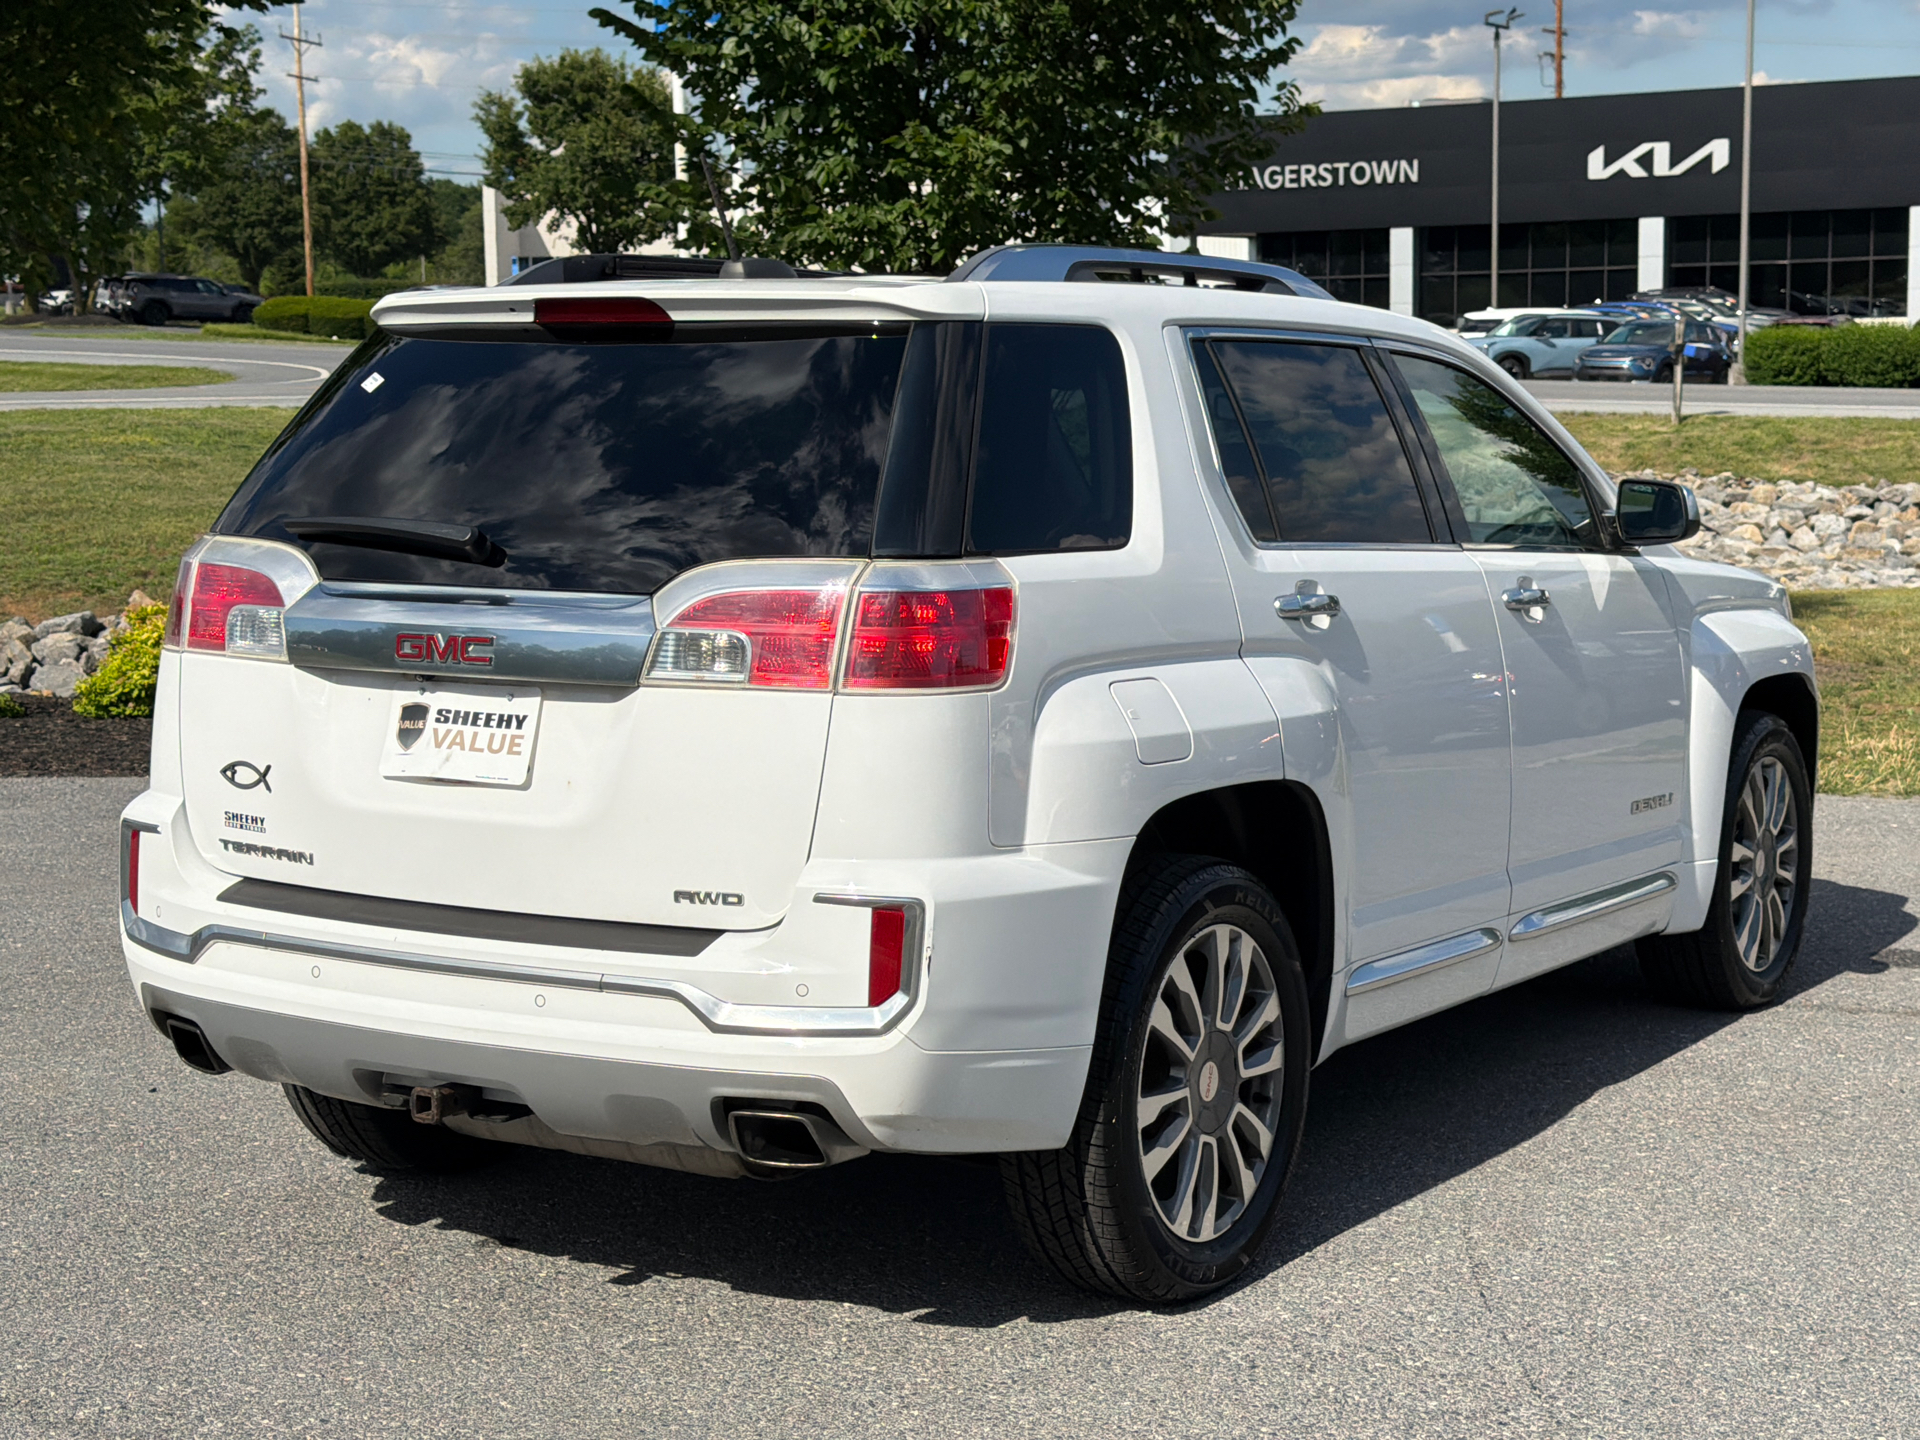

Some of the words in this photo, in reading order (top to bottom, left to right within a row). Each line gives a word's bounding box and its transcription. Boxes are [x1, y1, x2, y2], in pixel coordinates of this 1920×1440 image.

[1587, 138, 1730, 180] KIA
[395, 632, 496, 667] GMC
[399, 719, 427, 730] VALUE
[434, 708, 528, 730] SHEEHY
[432, 728, 525, 756] VALUE
[1630, 792, 1674, 815] DENALI
[224, 811, 265, 827] SHEEHY
[219, 838, 314, 866] TERRAIN
[673, 889, 745, 907] AWD
[1234, 888, 1280, 924] KELLY
[1205, 1064, 1214, 1099] GMC
